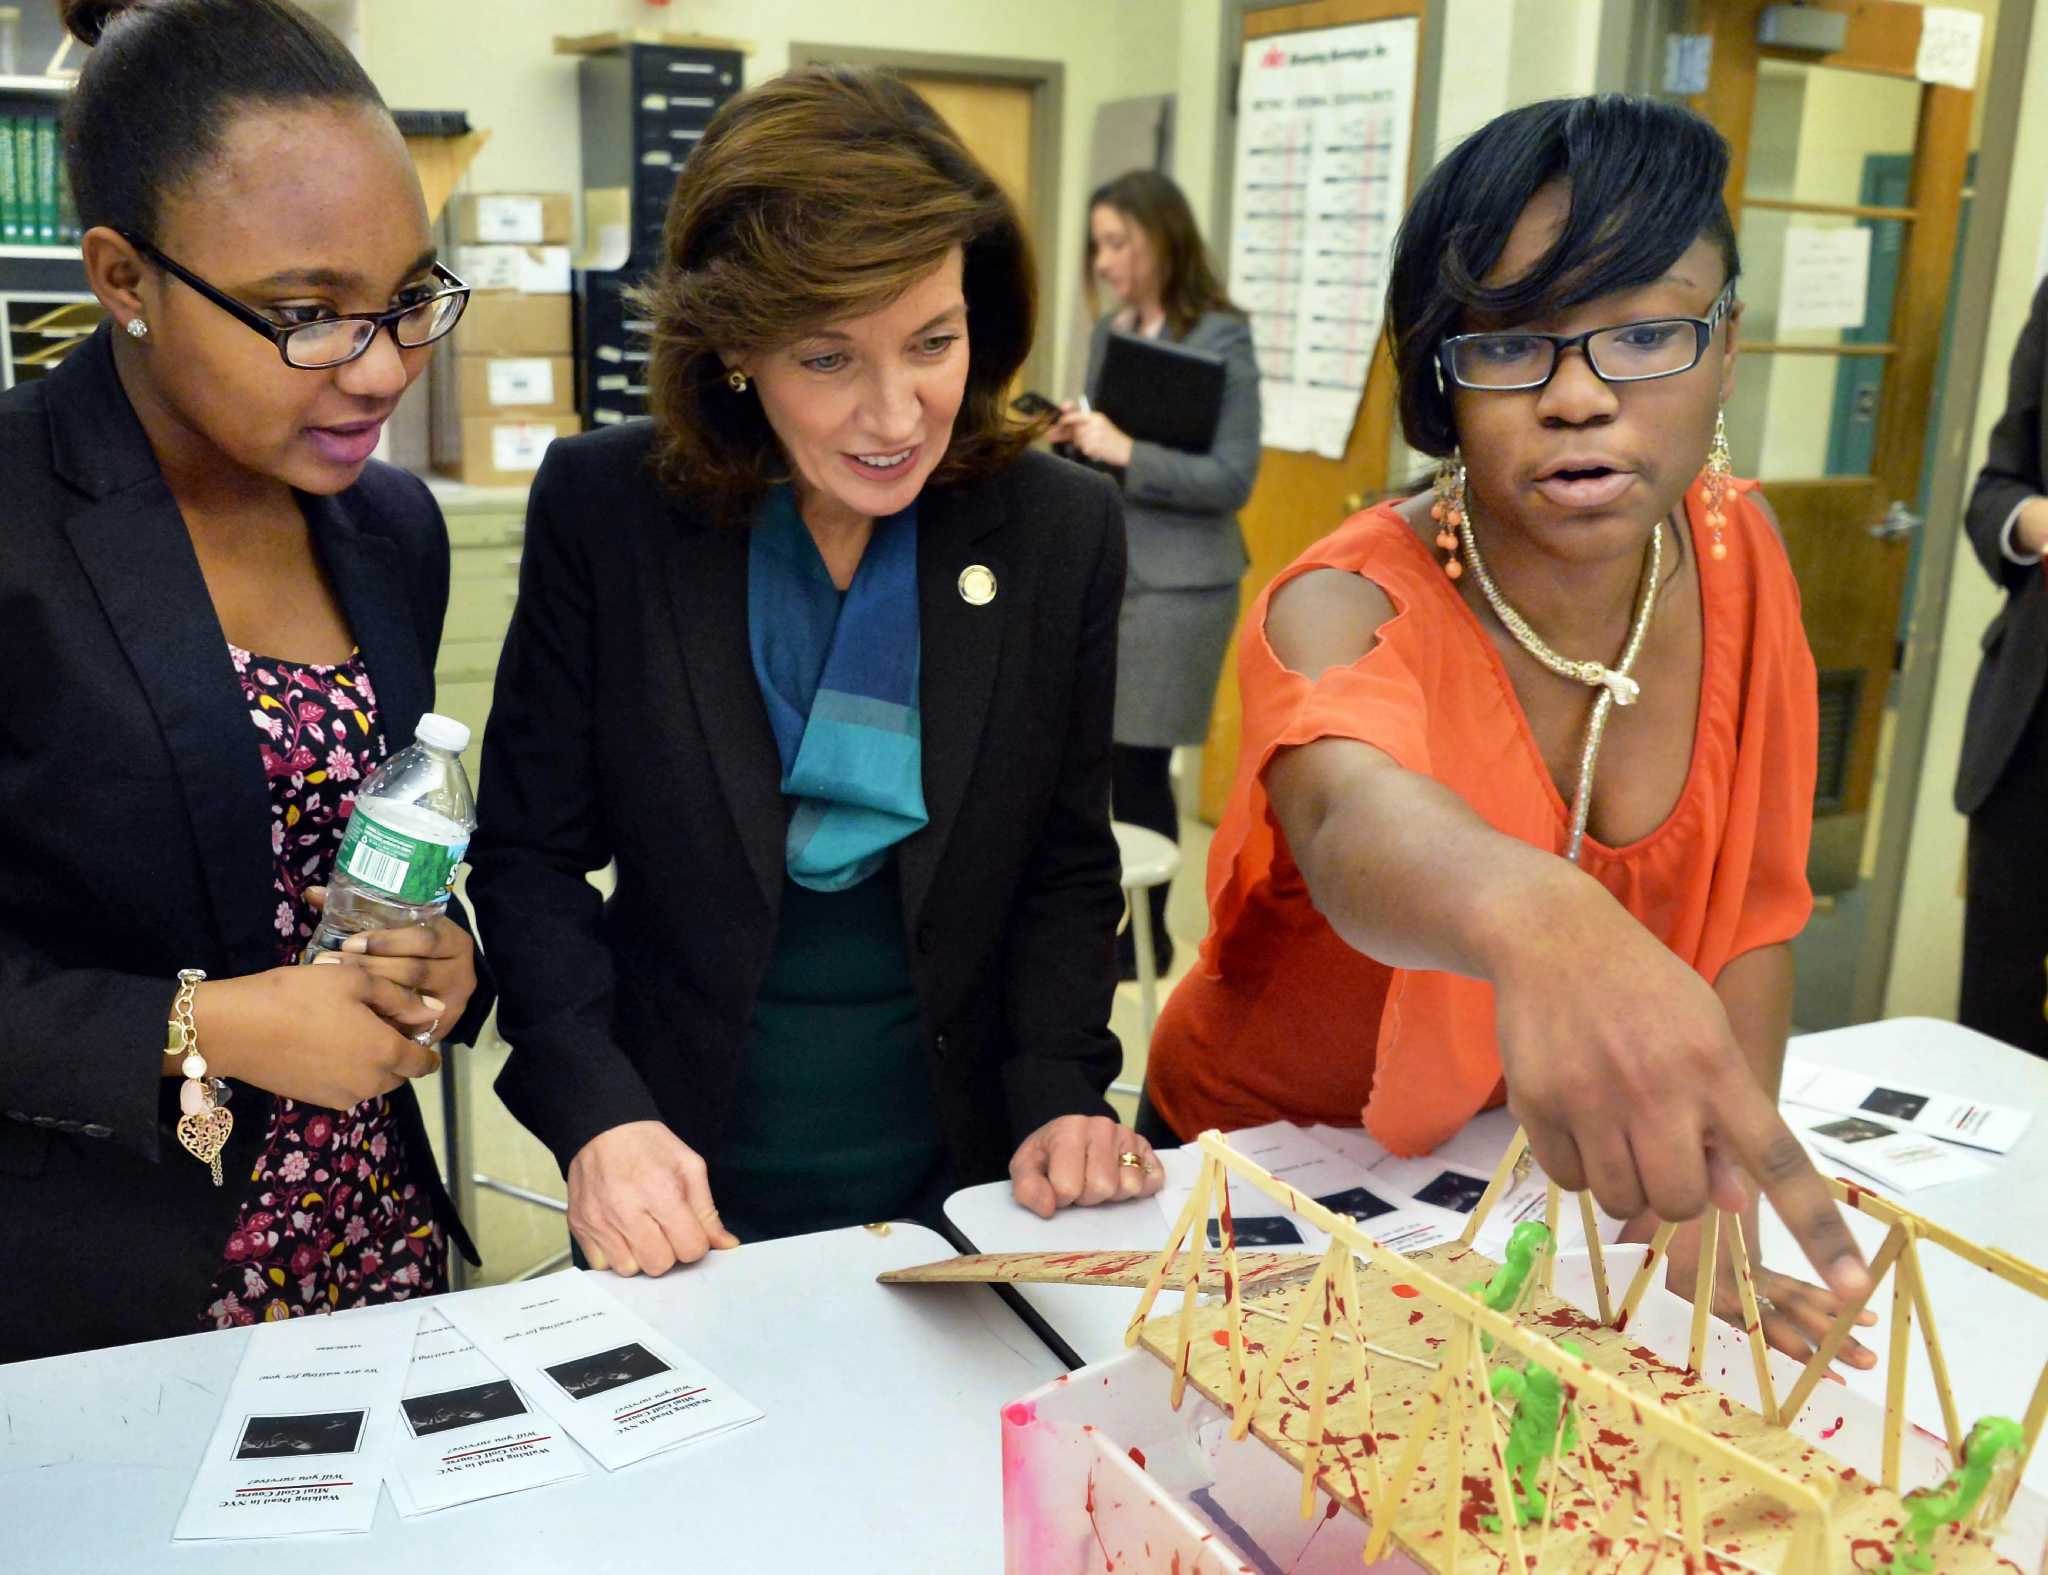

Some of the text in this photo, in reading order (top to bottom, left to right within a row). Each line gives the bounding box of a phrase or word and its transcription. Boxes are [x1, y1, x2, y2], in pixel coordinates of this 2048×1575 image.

[673, 1398, 712, 1412] Walking
[619, 1397, 695, 1424] Mini Golf Course
[650, 1411, 674, 1421] Dead
[616, 1425, 638, 1435] NYC
[516, 1431, 538, 1440] Will
[447, 1441, 491, 1454] survive?
[485, 1450, 507, 1458] Golf
[507, 1448, 550, 1459] Walking
[446, 1455, 482, 1465] Course
[479, 1457, 504, 1466] Dead
[437, 1466, 462, 1475] NYC
[248, 1477, 296, 1485] survive?
[296, 1495, 339, 1503] Walking
[220, 1500, 246, 1508] NYC
